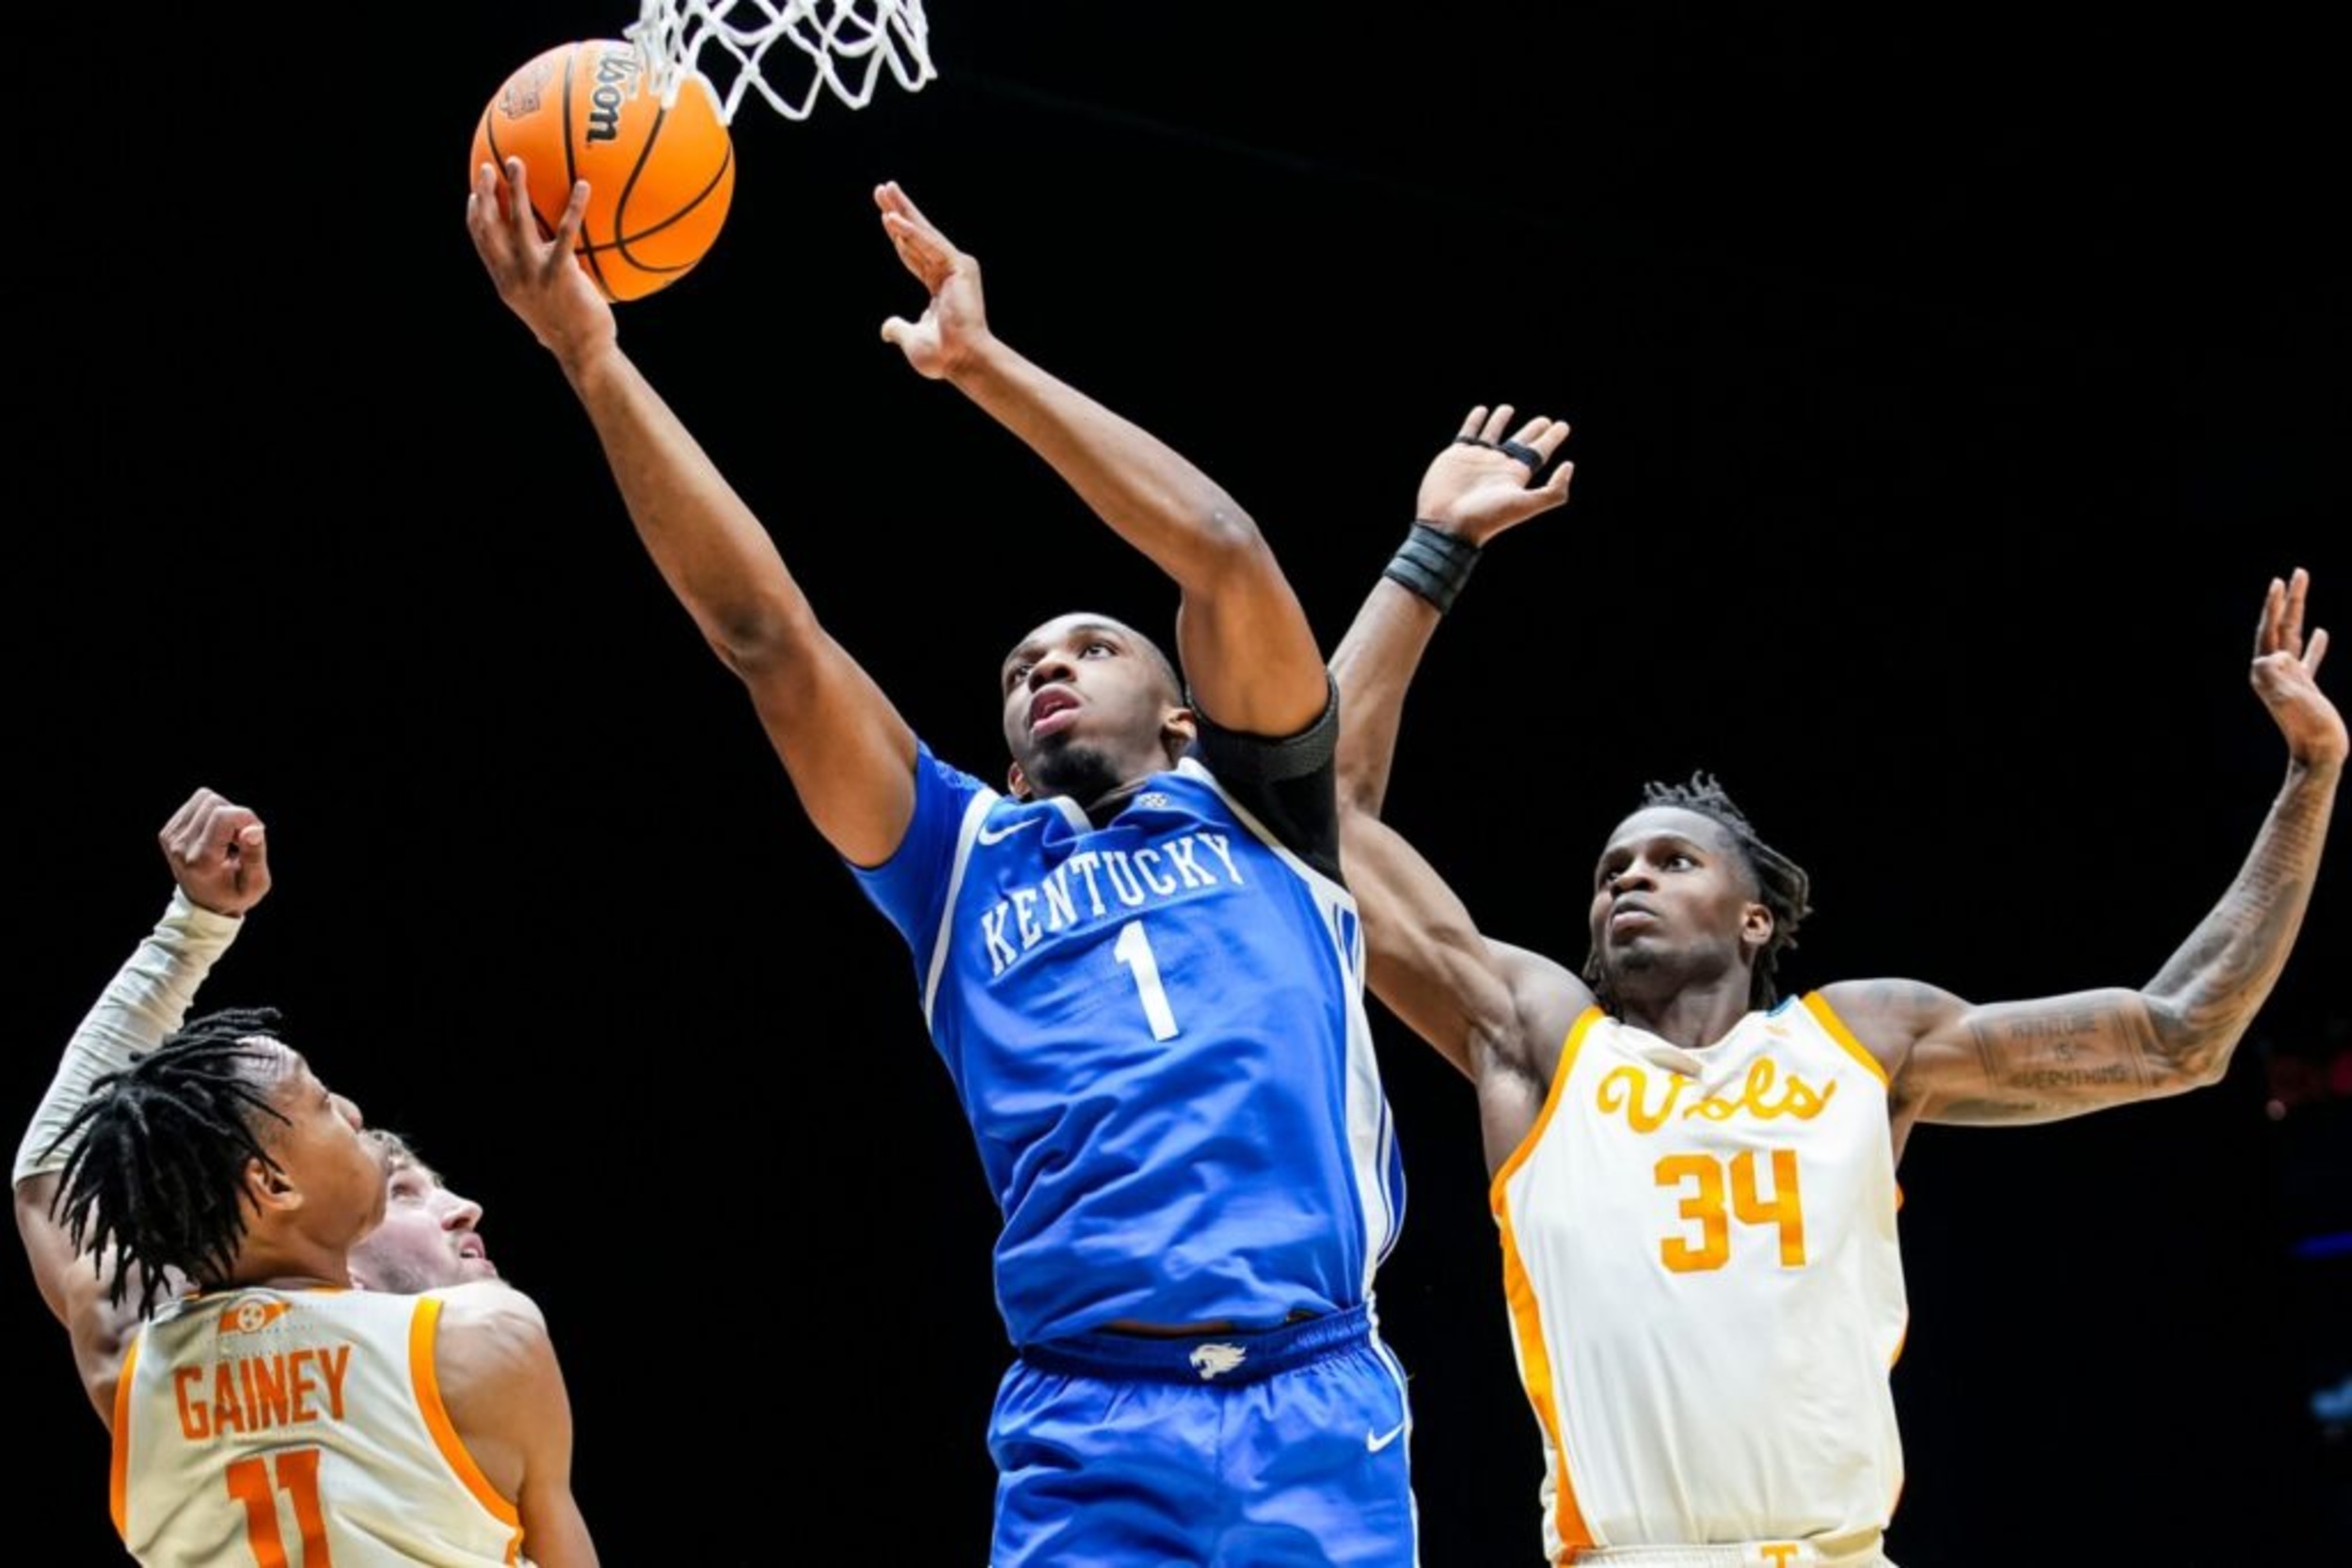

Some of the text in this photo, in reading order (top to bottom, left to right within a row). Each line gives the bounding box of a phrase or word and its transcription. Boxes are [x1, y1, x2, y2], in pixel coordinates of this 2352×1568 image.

[586, 54, 638, 145] lson
[980, 832, 1244, 975] KENTUCKY
[1112, 919, 1180, 1042] 1
[1597, 1056, 1836, 1134] Vols
[1653, 1148, 1806, 1275] 34
[175, 1345, 350, 1440] GAINEY
[226, 1448, 331, 1568] 11
